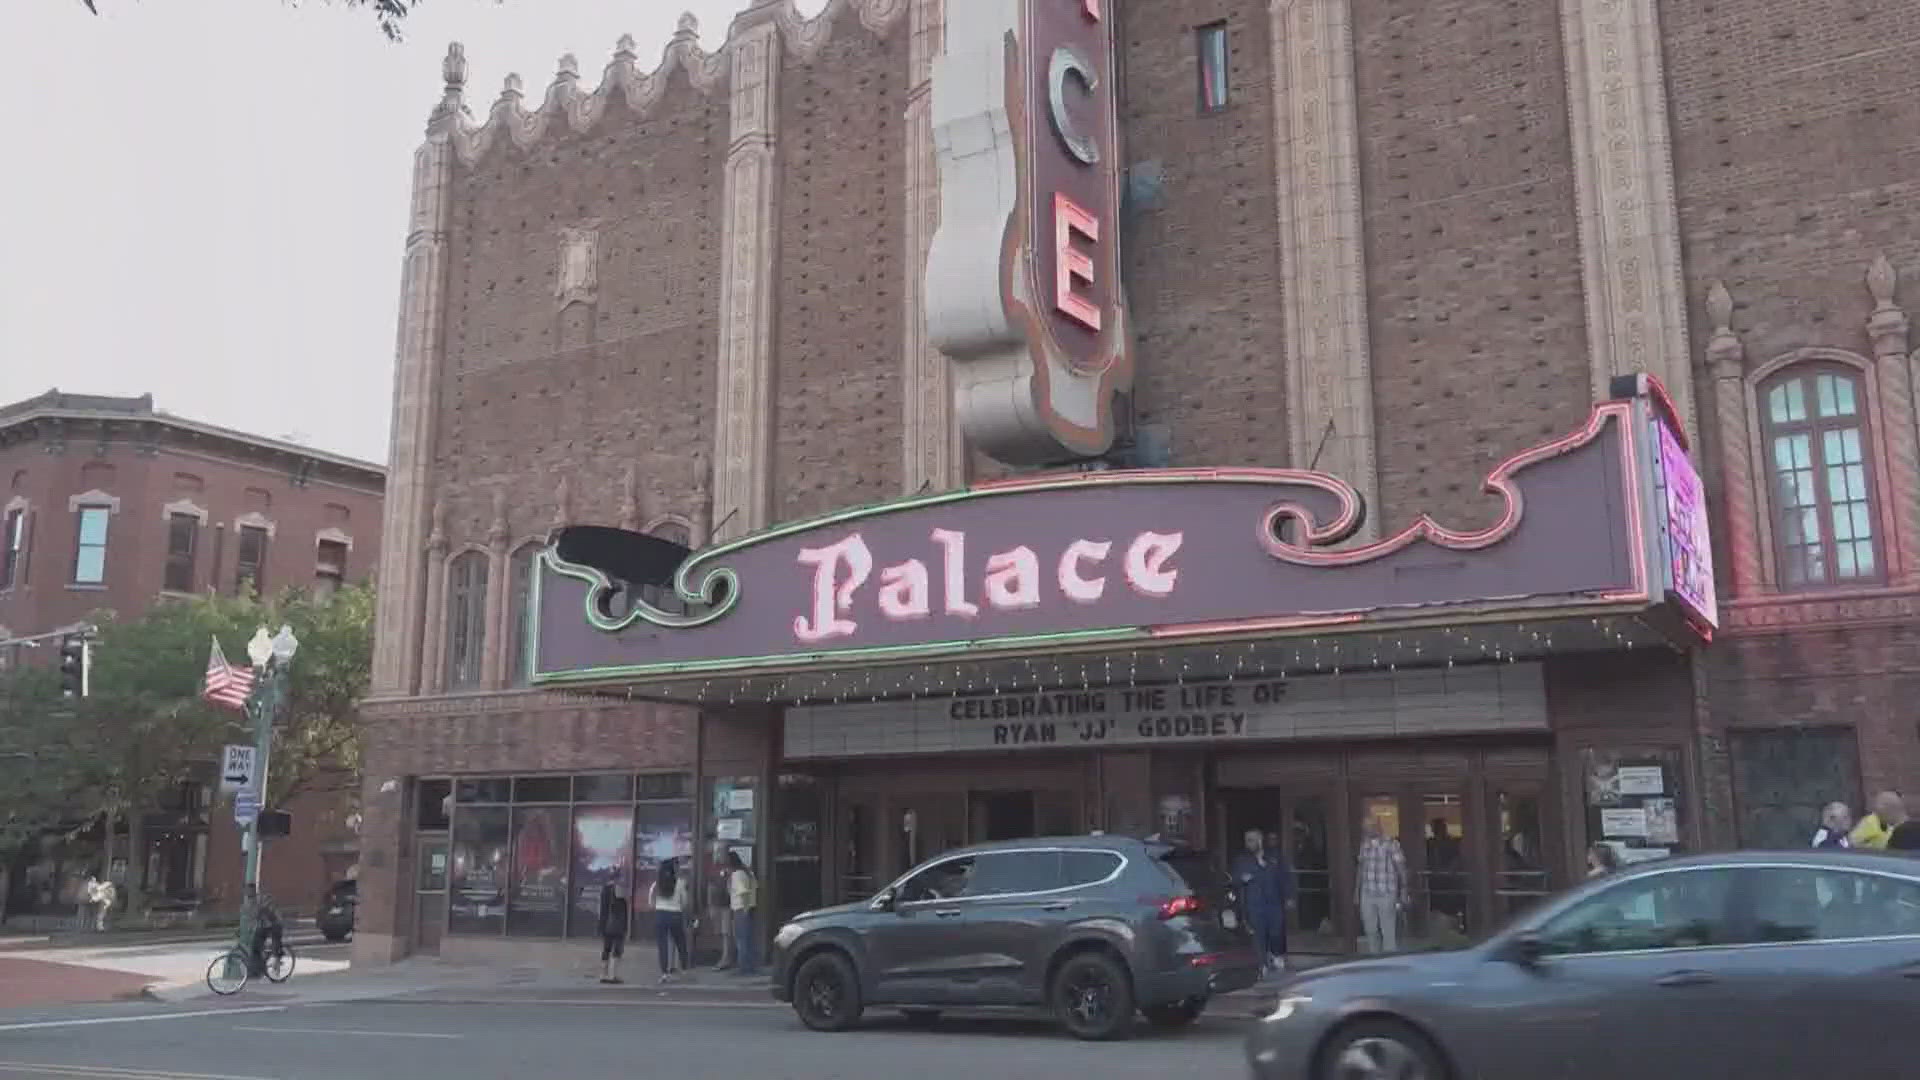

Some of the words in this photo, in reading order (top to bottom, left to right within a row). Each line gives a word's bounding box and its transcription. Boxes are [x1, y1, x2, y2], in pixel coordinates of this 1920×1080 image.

[1049, 0, 1100, 332] CE
[793, 528, 1184, 639] Palace
[950, 692, 1106, 721] CELEBRATING
[1121, 689, 1166, 713] THE
[1180, 685, 1235, 709] LIFE
[1253, 682, 1288, 704] OF
[994, 722, 1057, 745] RYAN
[1137, 712, 1246, 737] GODBEY
[228, 761, 252, 772] WAY
[230, 748, 252, 761] ONE
